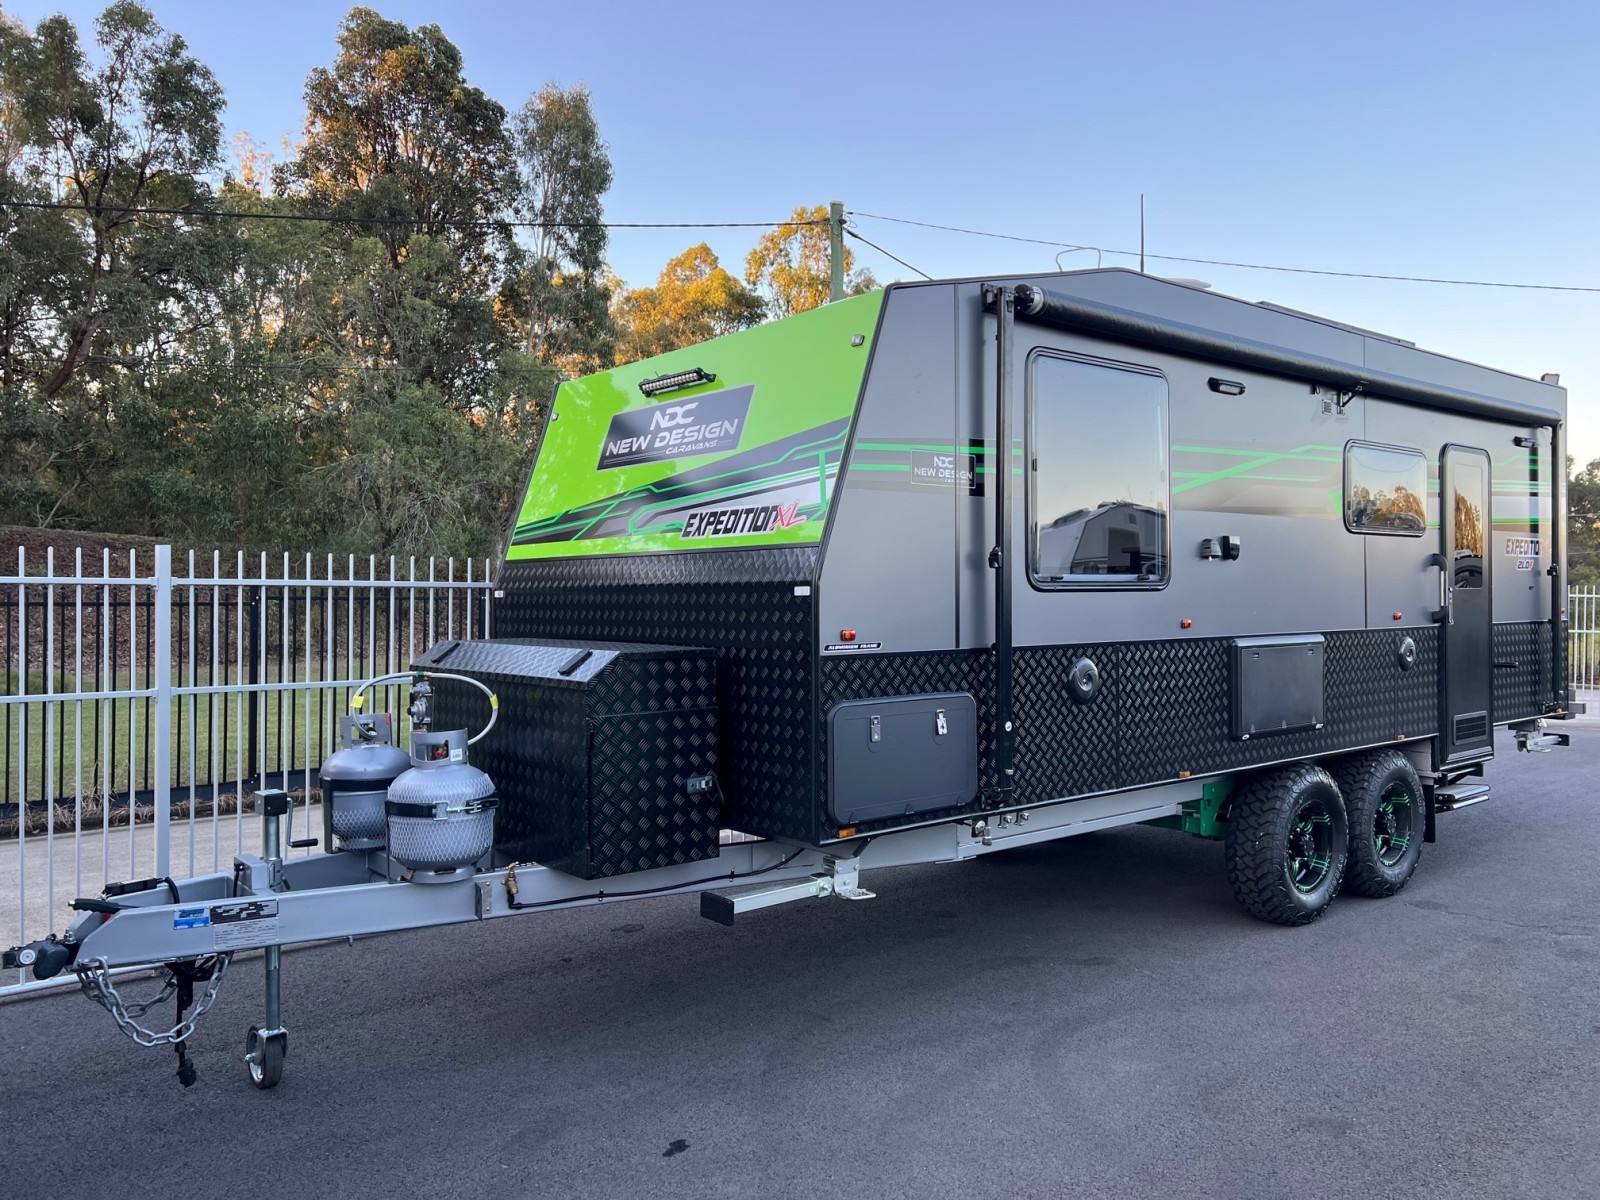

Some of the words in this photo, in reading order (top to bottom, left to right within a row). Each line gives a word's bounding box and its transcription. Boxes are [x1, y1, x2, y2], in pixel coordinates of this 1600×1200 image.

[650, 402, 698, 430] NDC
[605, 434, 651, 456] NEW
[654, 418, 738, 447] DESIGN
[665, 440, 717, 454] CARAVANS
[934, 456, 954, 468] NDC
[914, 467, 936, 477] NEW
[939, 469, 972, 479] DESIGN
